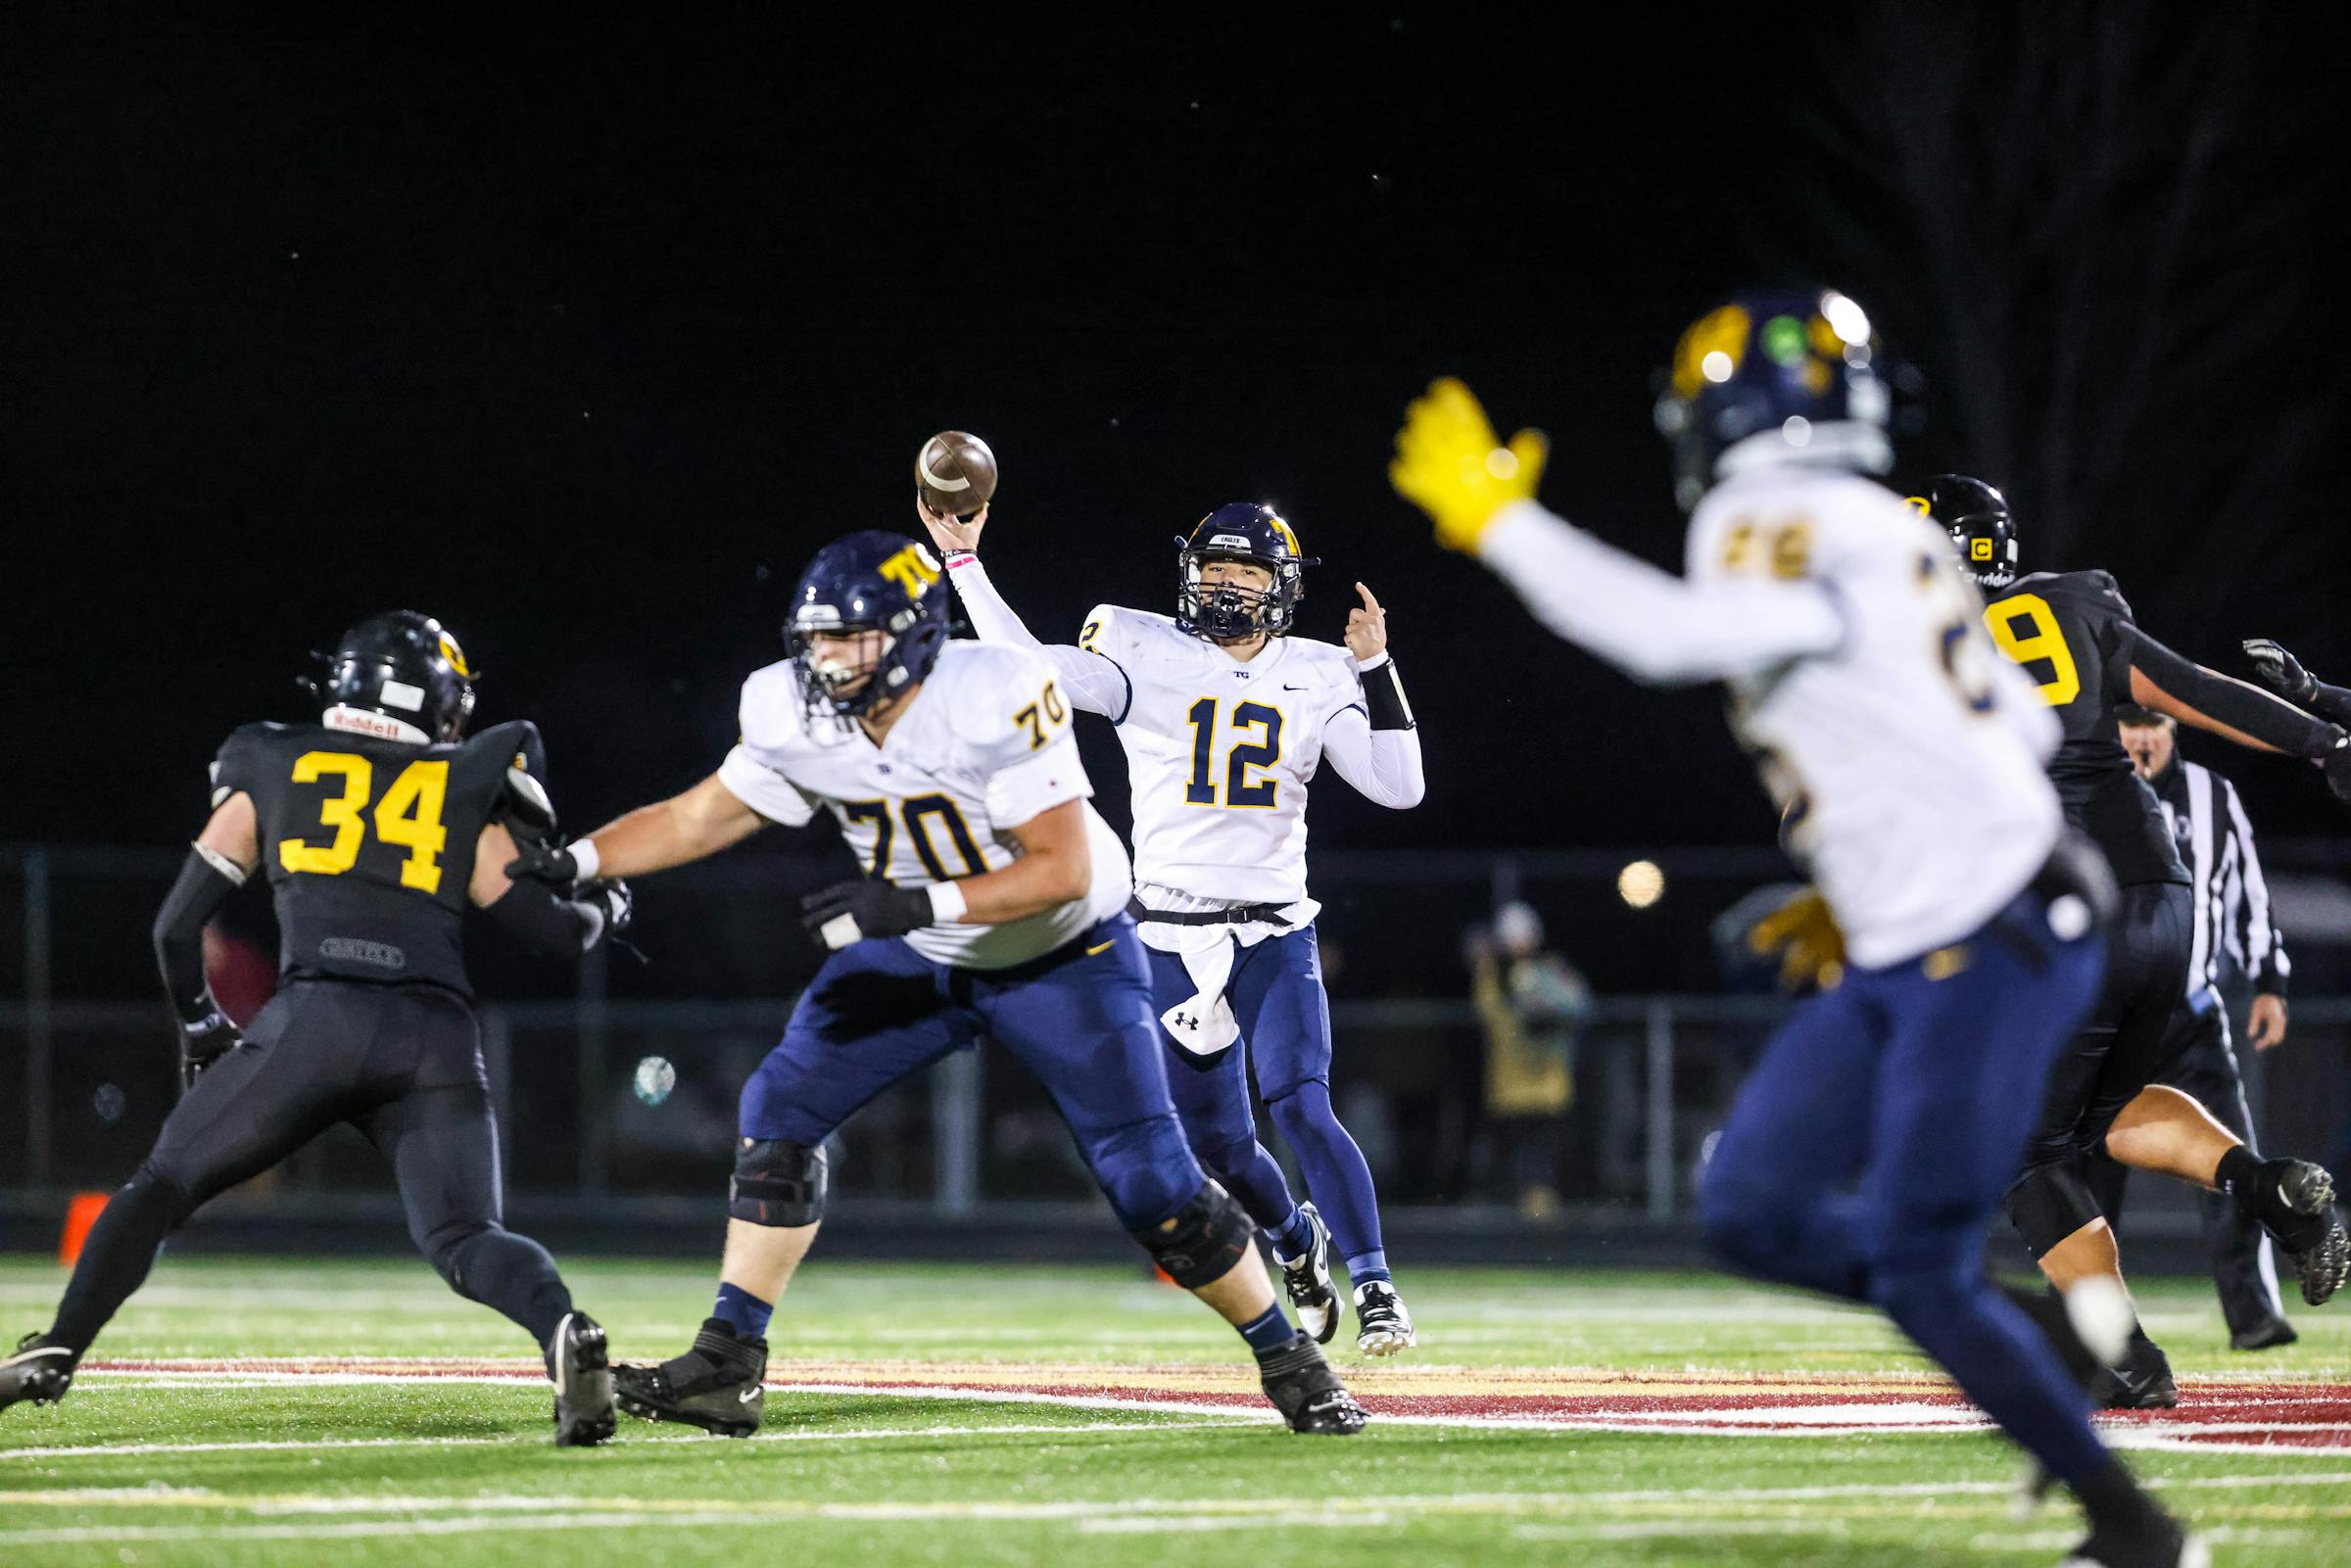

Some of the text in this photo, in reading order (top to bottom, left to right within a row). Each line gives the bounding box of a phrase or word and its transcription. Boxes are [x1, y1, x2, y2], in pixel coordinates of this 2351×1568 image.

[1974, 542, 1990, 557] C
[1233, 671, 1250, 680] TG
[1983, 594, 2081, 707] 9
[1012, 680, 1066, 752] 70
[1184, 695, 1285, 810] 12
[279, 751, 450, 894] 34
[844, 790, 990, 888] 70
